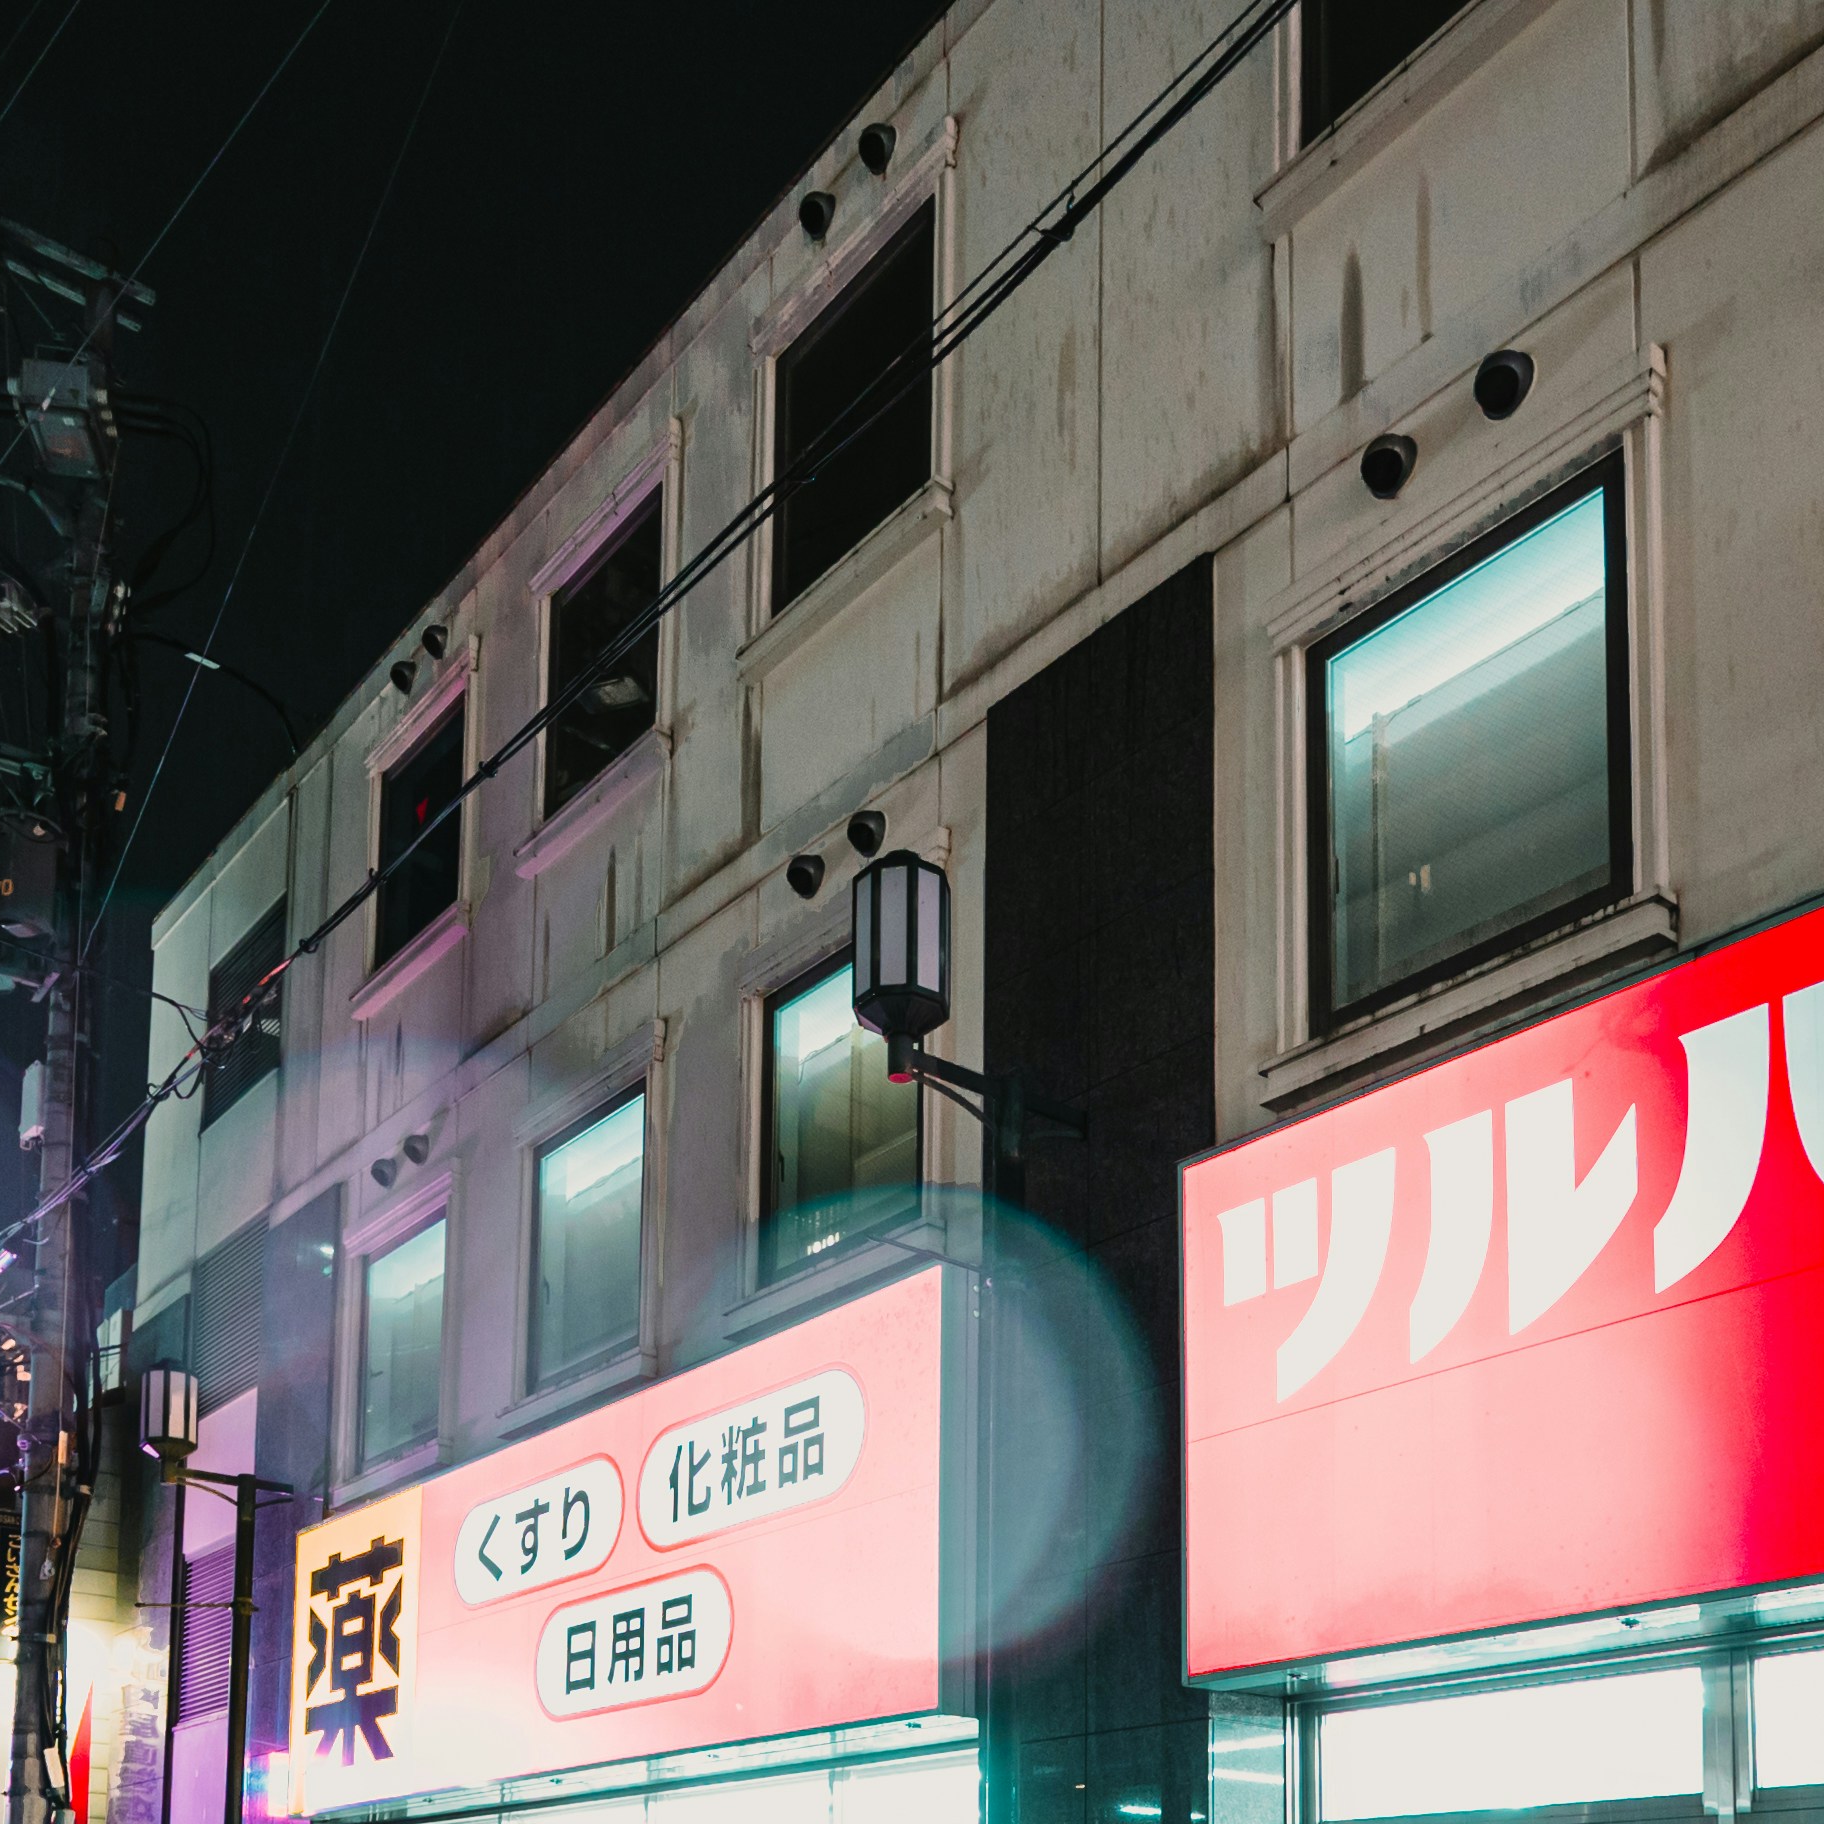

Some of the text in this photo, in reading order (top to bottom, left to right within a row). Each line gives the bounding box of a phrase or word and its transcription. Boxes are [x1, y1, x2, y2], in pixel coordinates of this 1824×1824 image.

[668, 1395, 826, 1524] 化粧品
[478, 1486, 591, 1582] くすり
[306, 1535, 404, 1767] 薬
[564, 1593, 697, 1696] 日用品
